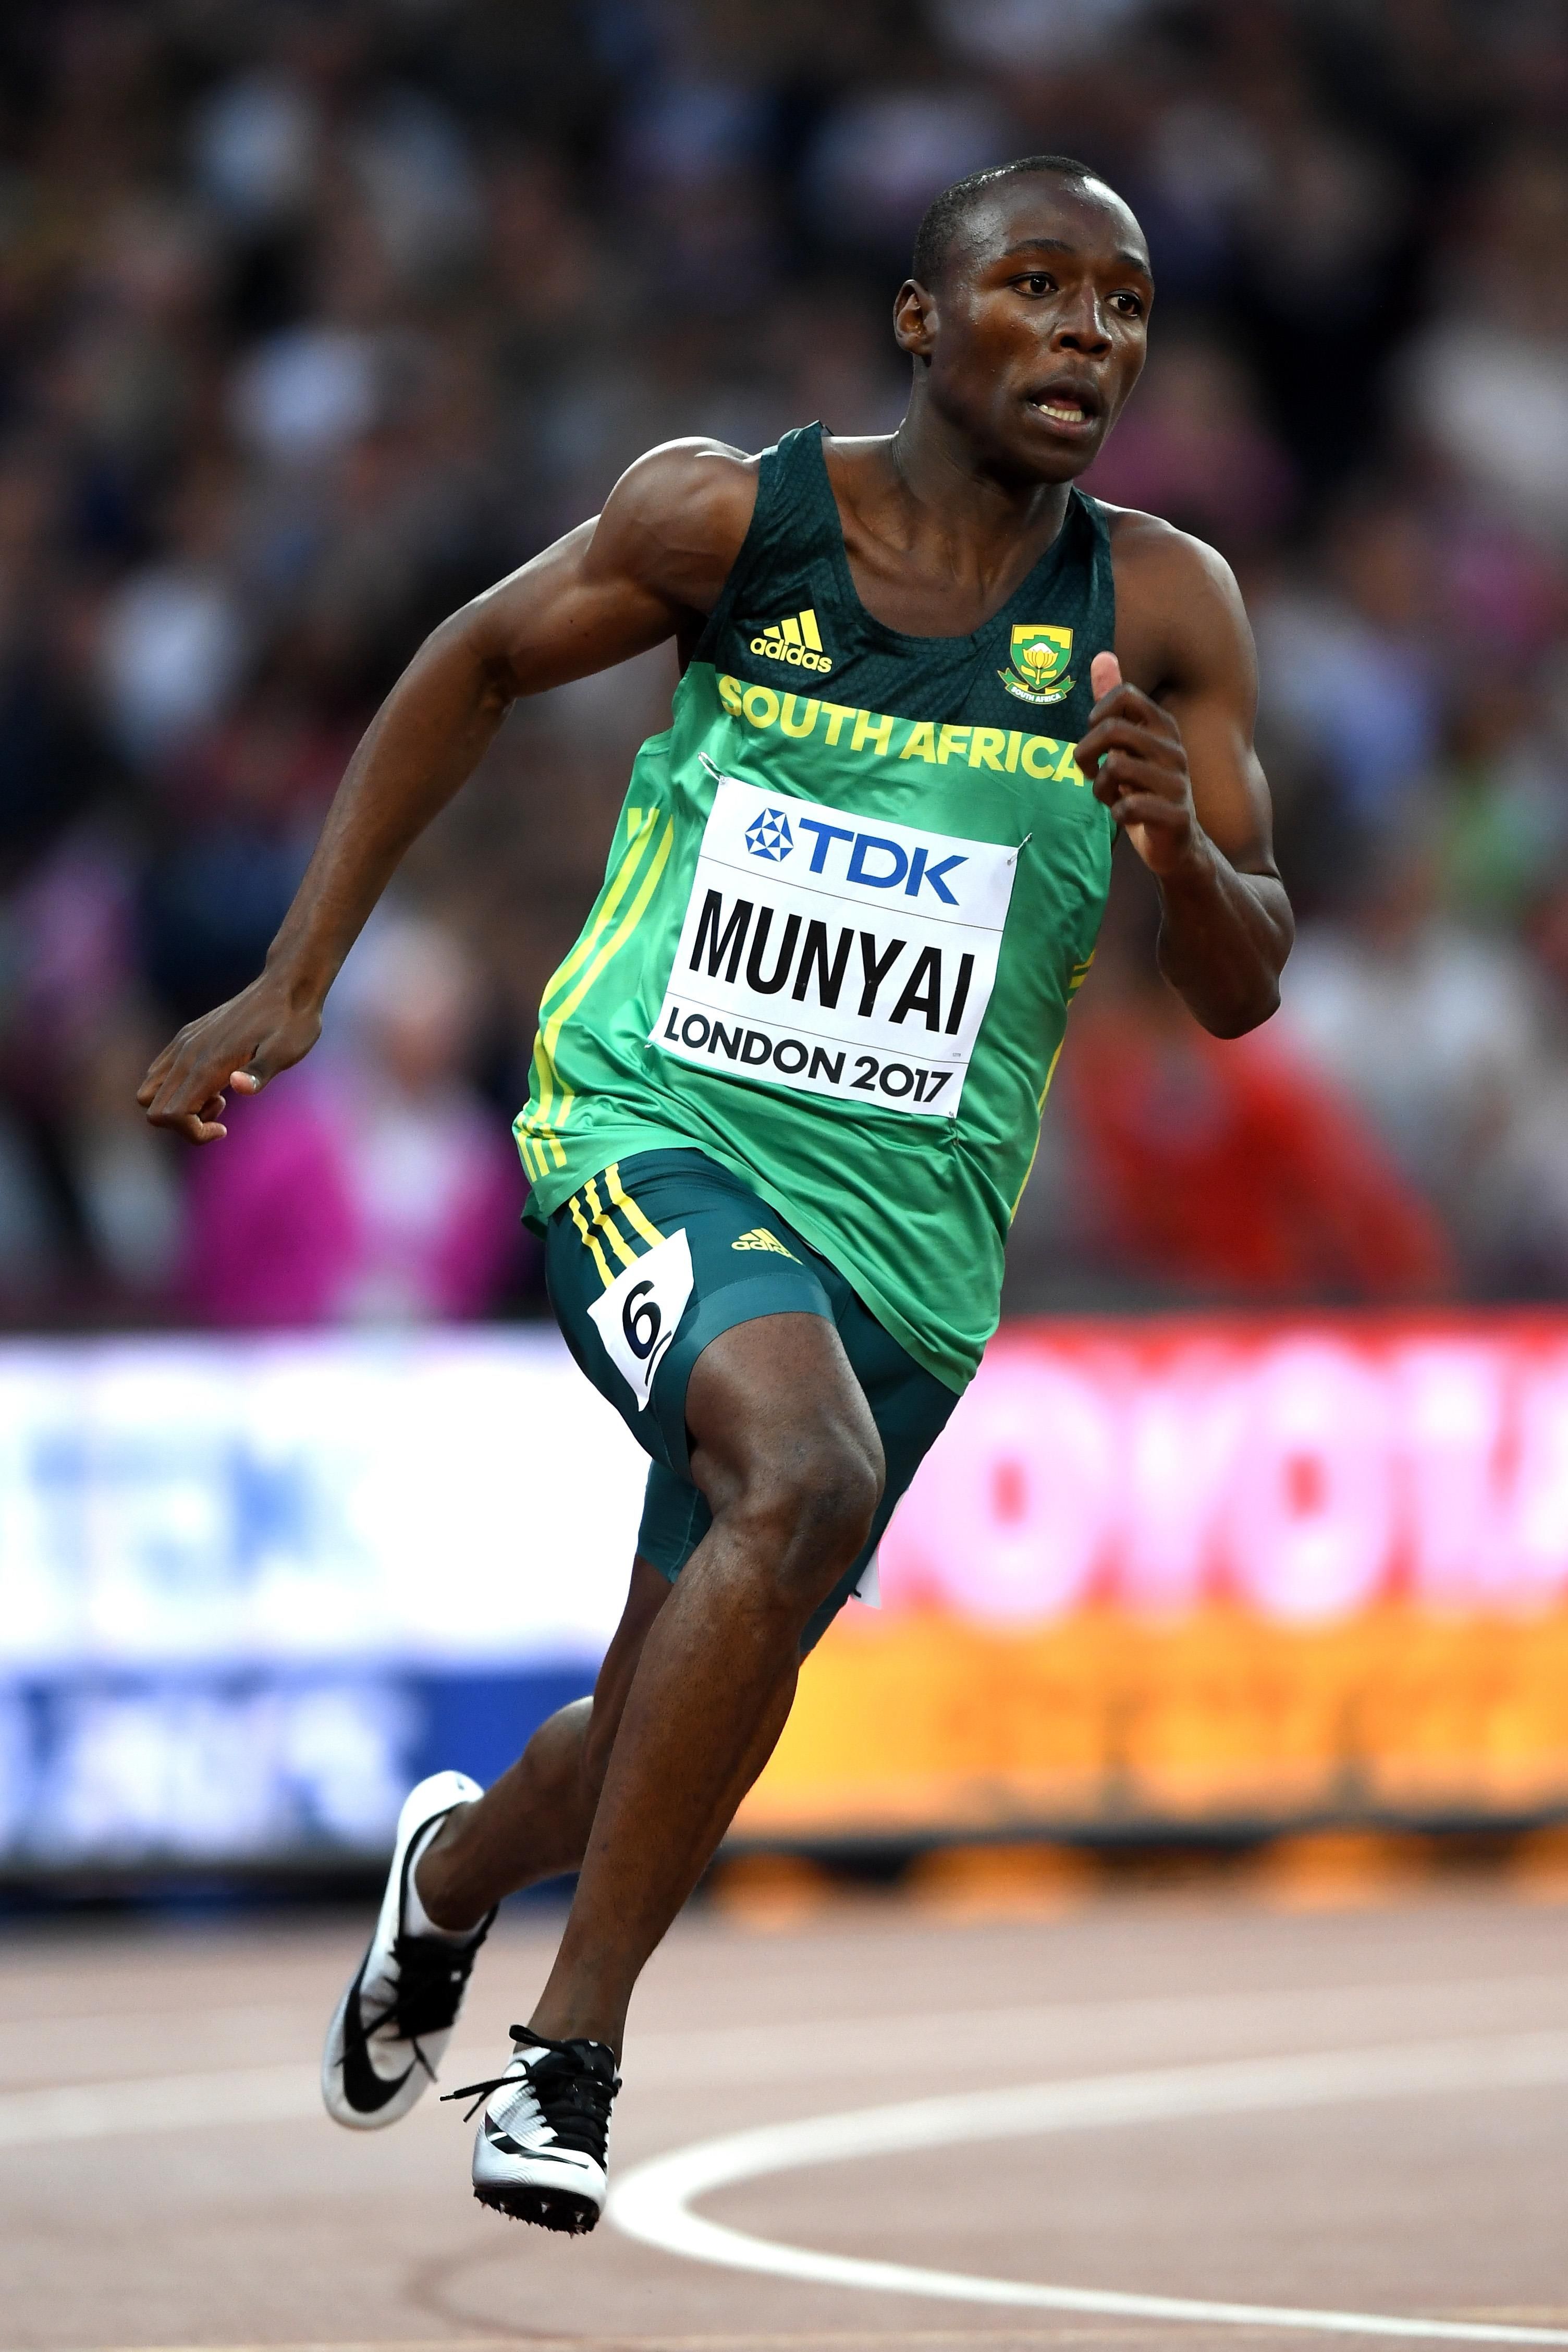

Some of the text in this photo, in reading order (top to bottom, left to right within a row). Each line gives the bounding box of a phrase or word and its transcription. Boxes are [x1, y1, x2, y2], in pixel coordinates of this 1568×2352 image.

[750, 638, 832, 673] adidas
[1010, 686, 1061, 703] SOUTH AFRICA
[719, 675, 1084, 787] SOUTH AFRICA
[798, 817, 970, 906] TDK
[689, 888, 975, 1036] MUNYAI
[664, 1007, 953, 1103] LONDON 2017
[731, 1239, 805, 1267] adid
[622, 1280, 662, 1360] 6
